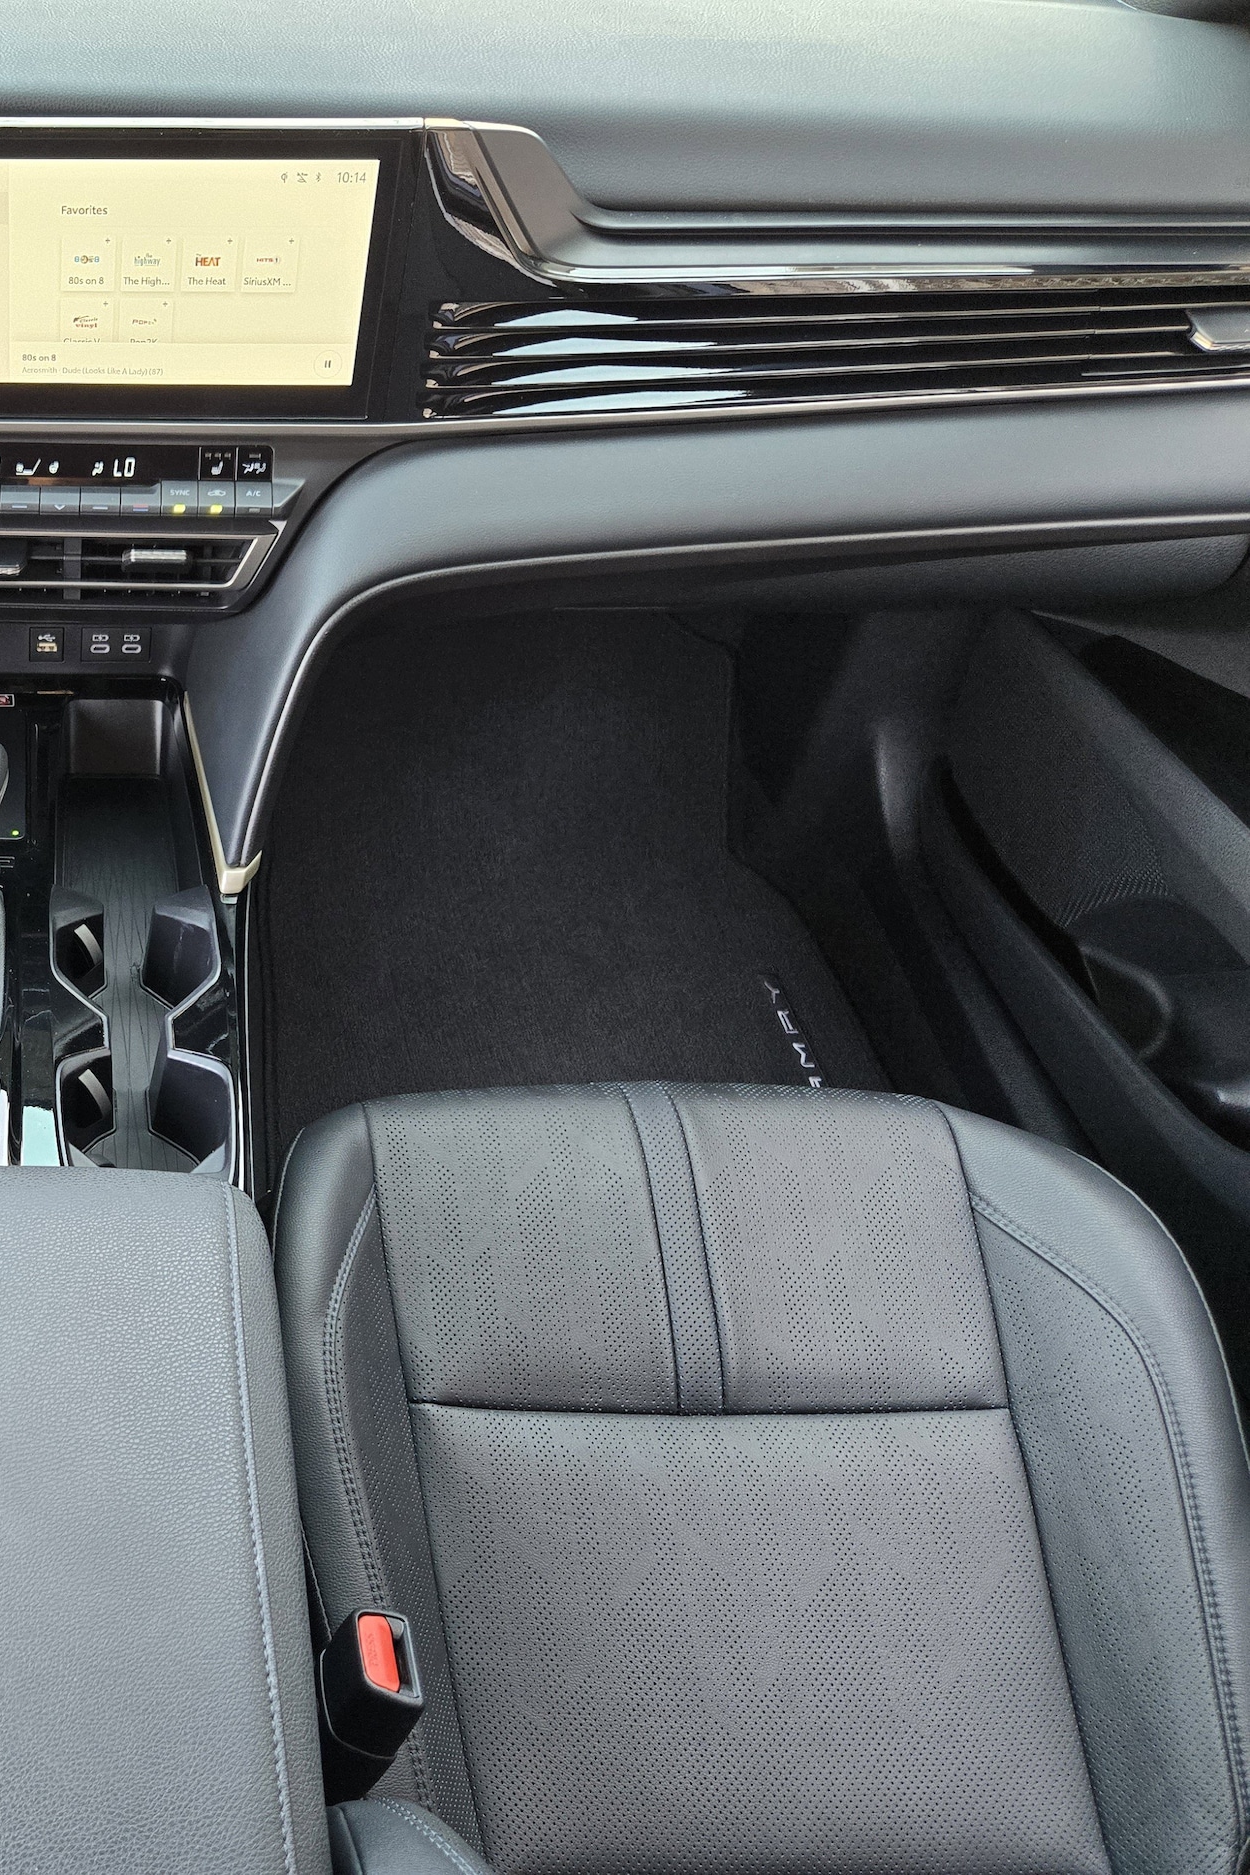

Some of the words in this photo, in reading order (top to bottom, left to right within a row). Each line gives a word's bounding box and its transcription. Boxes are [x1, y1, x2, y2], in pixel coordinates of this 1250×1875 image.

[336, 171, 367, 184] 10:14
[61, 205, 108, 215] Favorites
[195, 257, 221, 267] HEAT
[68, 276, 83, 285] 80s
[98, 276, 104, 285] 8
[123, 276, 140, 285] The
[188, 277, 203, 285] The
[206, 277, 226, 285] Heat
[244, 277, 281, 286] SiriusXM
[82, 367, 105, 375] (Looks
[107, 367, 120, 375] Like
[129, 368, 148, 376] Lady)
